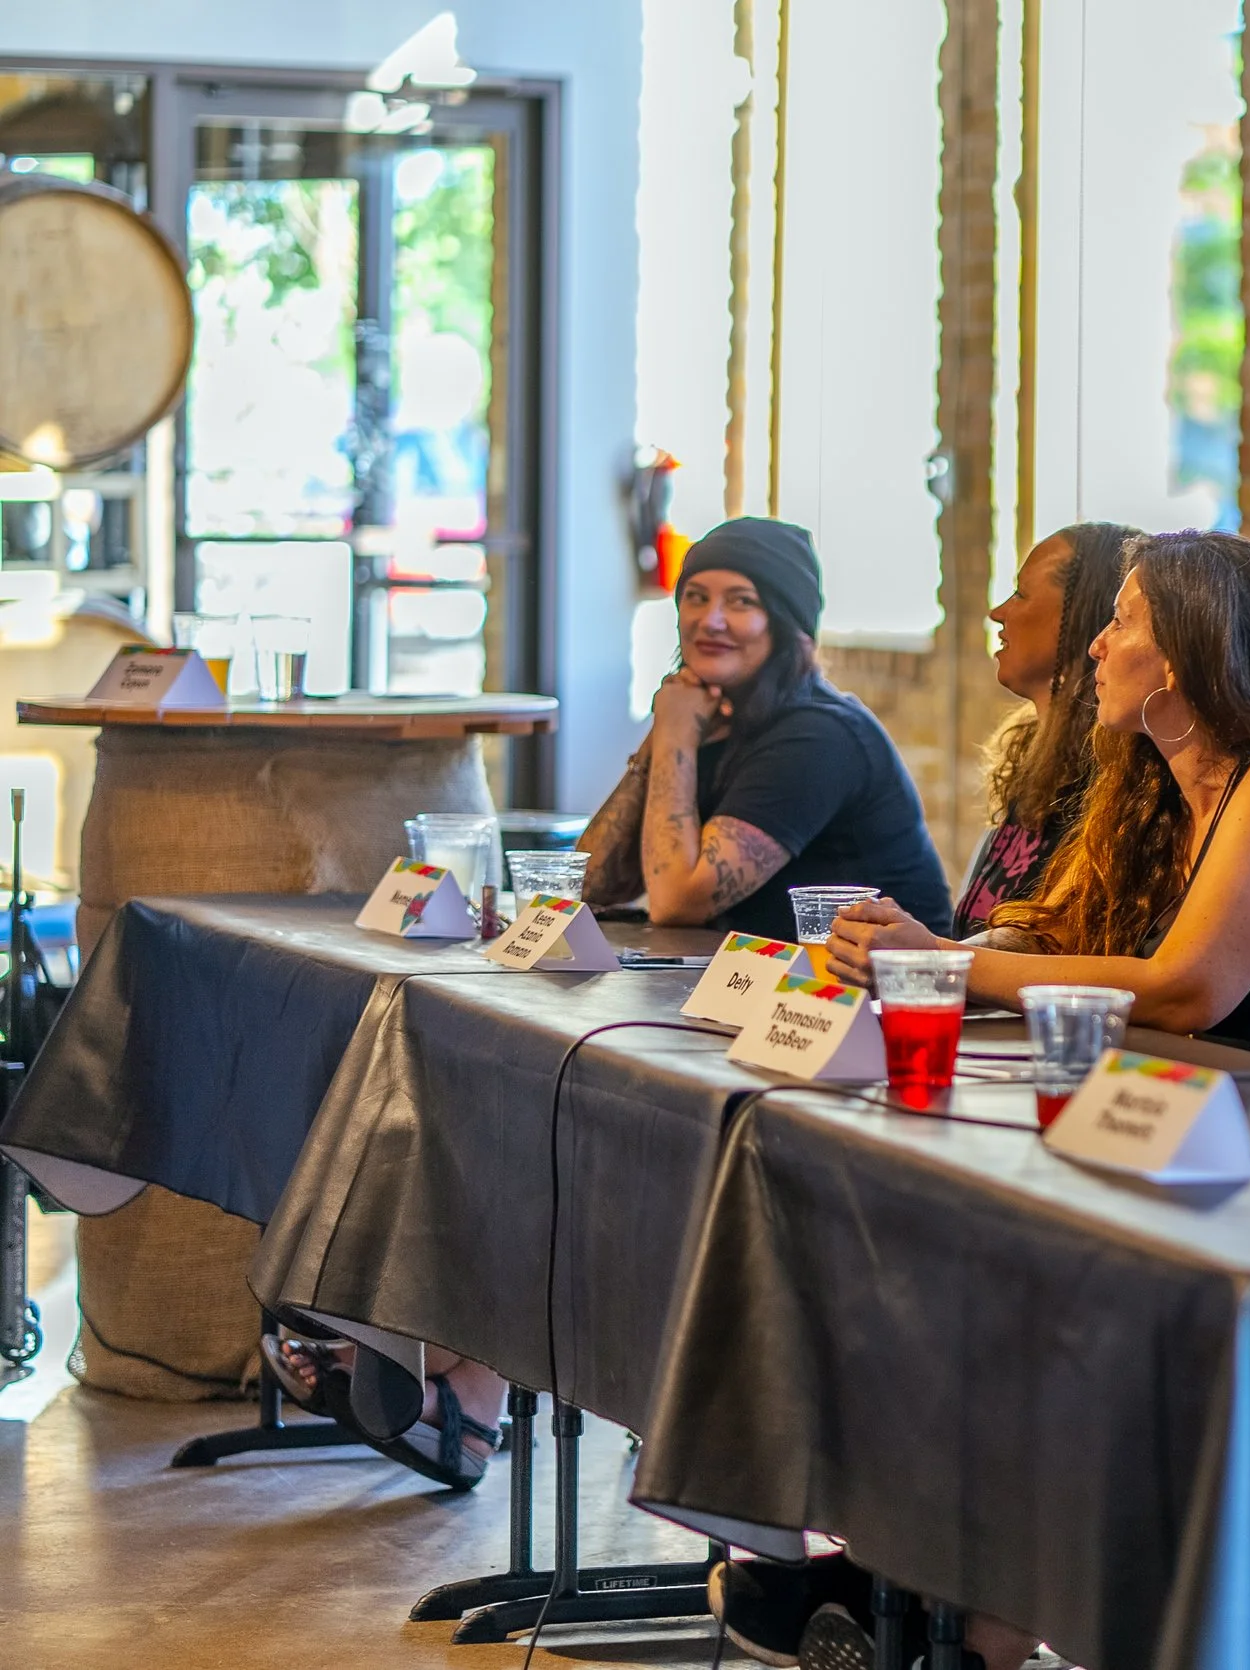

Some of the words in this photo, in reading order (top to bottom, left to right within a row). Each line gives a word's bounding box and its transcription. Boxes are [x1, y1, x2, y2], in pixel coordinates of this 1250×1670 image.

[726, 972, 755, 996] Deity
[770, 1002, 834, 1034] Thomasina
[764, 1024, 814, 1052] TopBear
[602, 1578, 650, 1589] LIFETIME
